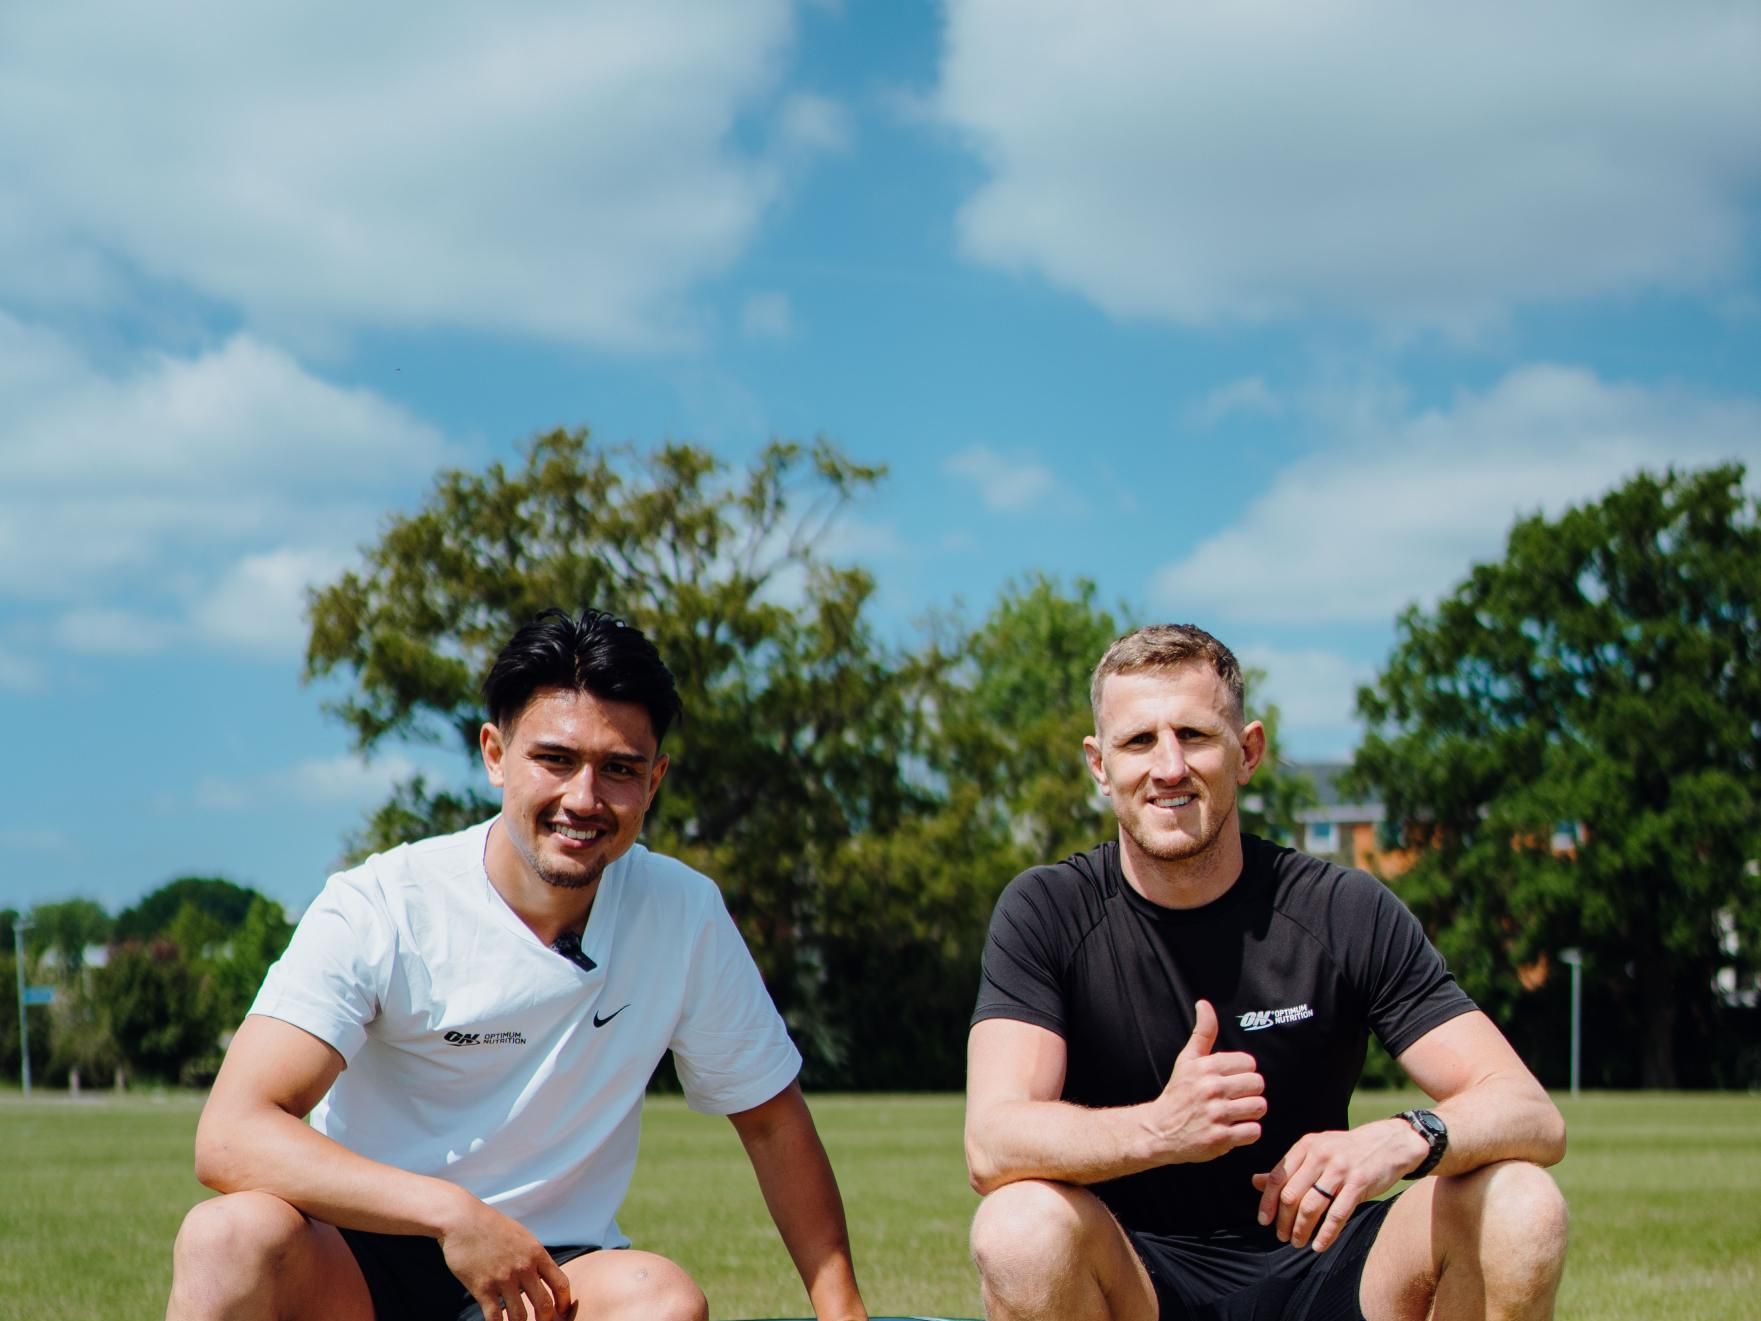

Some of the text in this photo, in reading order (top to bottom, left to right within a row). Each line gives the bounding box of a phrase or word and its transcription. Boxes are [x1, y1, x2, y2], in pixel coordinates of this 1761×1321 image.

[1274, 1004, 1308, 1017] OPTIMUM
[1275, 1009, 1314, 1024] NUTRITION
[1239, 1011, 1274, 1031] ON
[443, 1031, 480, 1046] ON
[483, 1037, 527, 1045] NUTRITION
[484, 1032, 522, 1040] OPTIMUM
